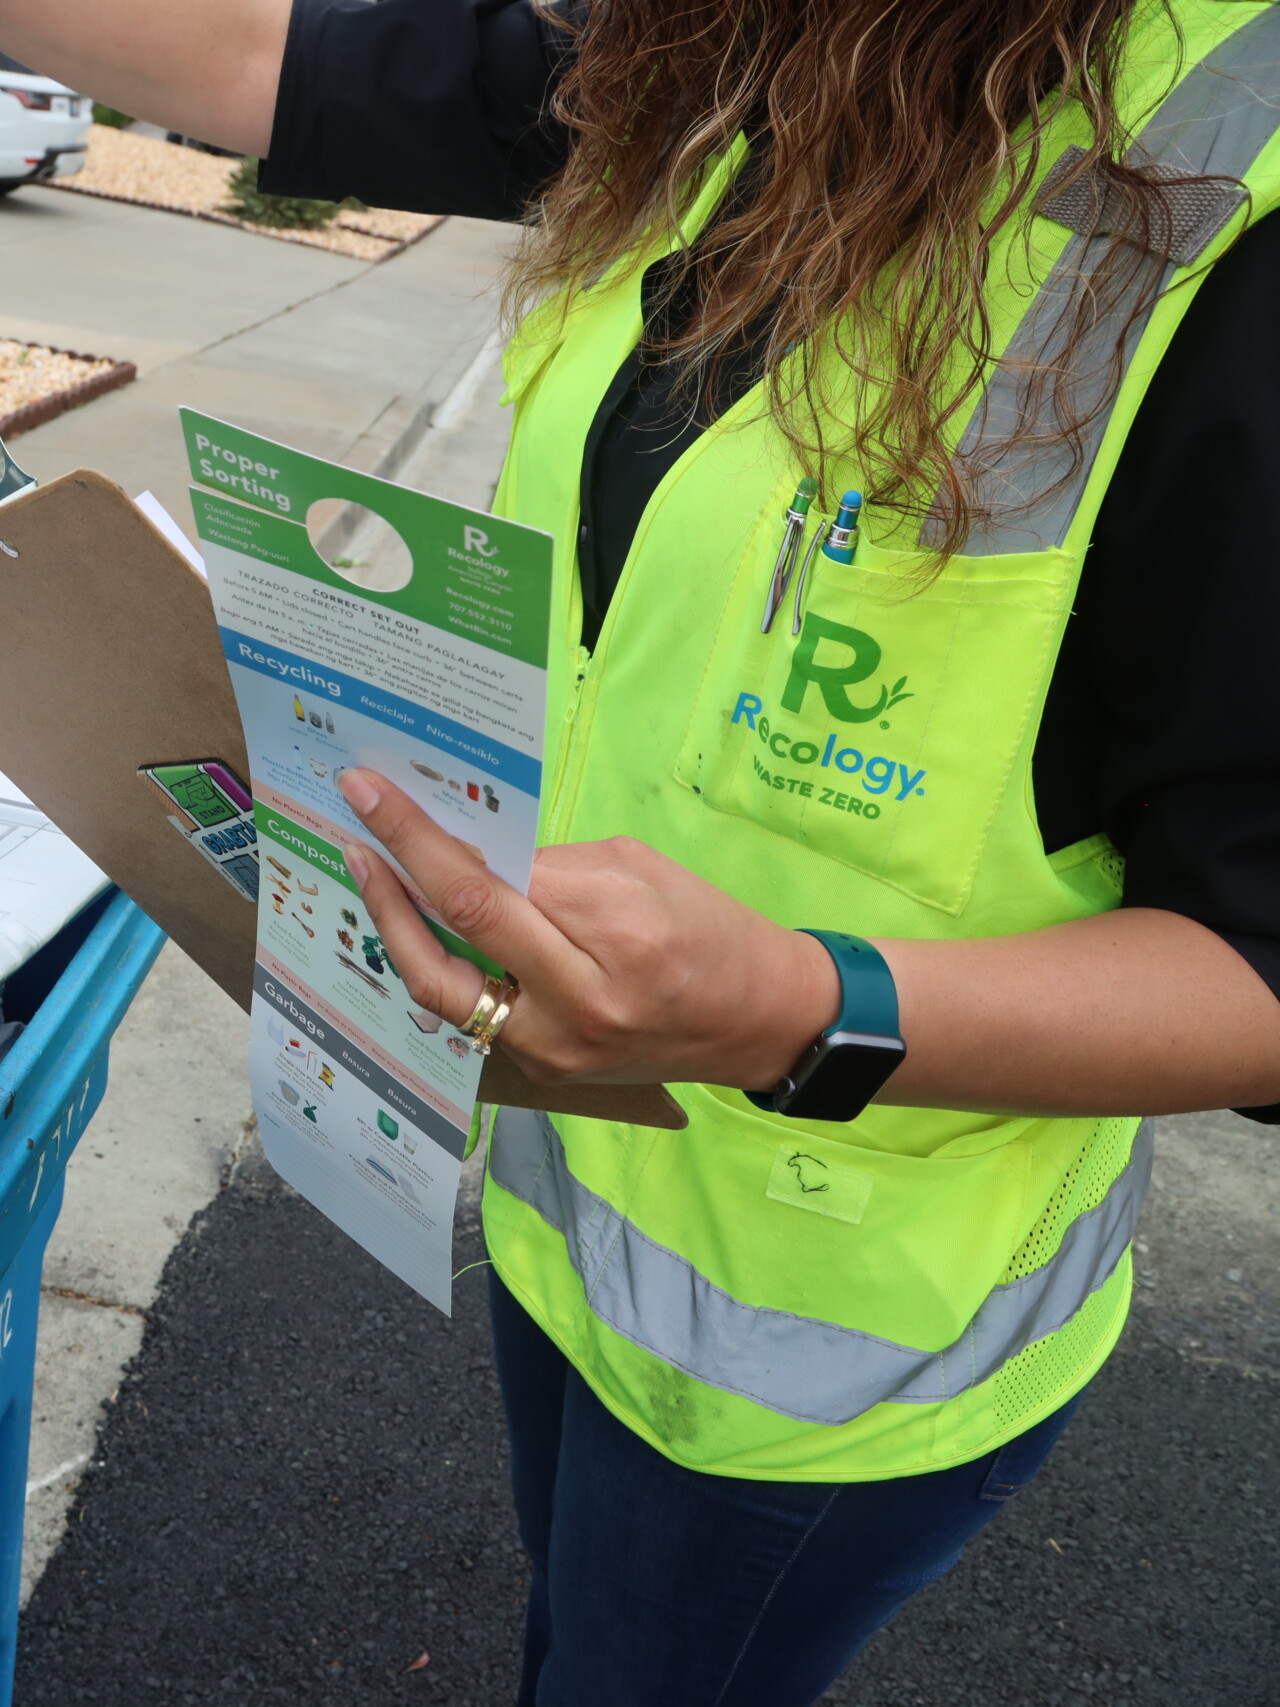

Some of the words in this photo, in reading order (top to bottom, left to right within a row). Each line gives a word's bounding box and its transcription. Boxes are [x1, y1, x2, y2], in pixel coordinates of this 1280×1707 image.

[195, 433, 280, 480] Proper
[200, 458, 291, 512] Sorting
[206, 514, 252, 536] Adecuada
[447, 547, 510, 578] Recology
[237, 568, 289, 595] TRAZADO
[292, 589, 354, 620] CORRECTO
[312, 587, 365, 614] CORRECT
[370, 609, 390, 624] SET
[395, 619, 419, 635] OUT
[445, 586, 515, 618] Recology.com
[448, 615, 513, 645] WhatBin.com
[238, 642, 342, 697] Recycling
[781, 610, 900, 723] R
[360, 695, 416, 725] Reciclaje
[426, 724, 500, 766] Nire-resiklo
[731, 692, 927, 801] Recology
[753, 754, 814, 798] WASTE
[818, 787, 881, 820] ZERO
[199, 805, 226, 819] STAND
[267, 819, 347, 877] Compost
[264, 981, 325, 1040] Garbage
[342, 1051, 370, 1078] Basura
[387, 1088, 417, 1116] Basura
